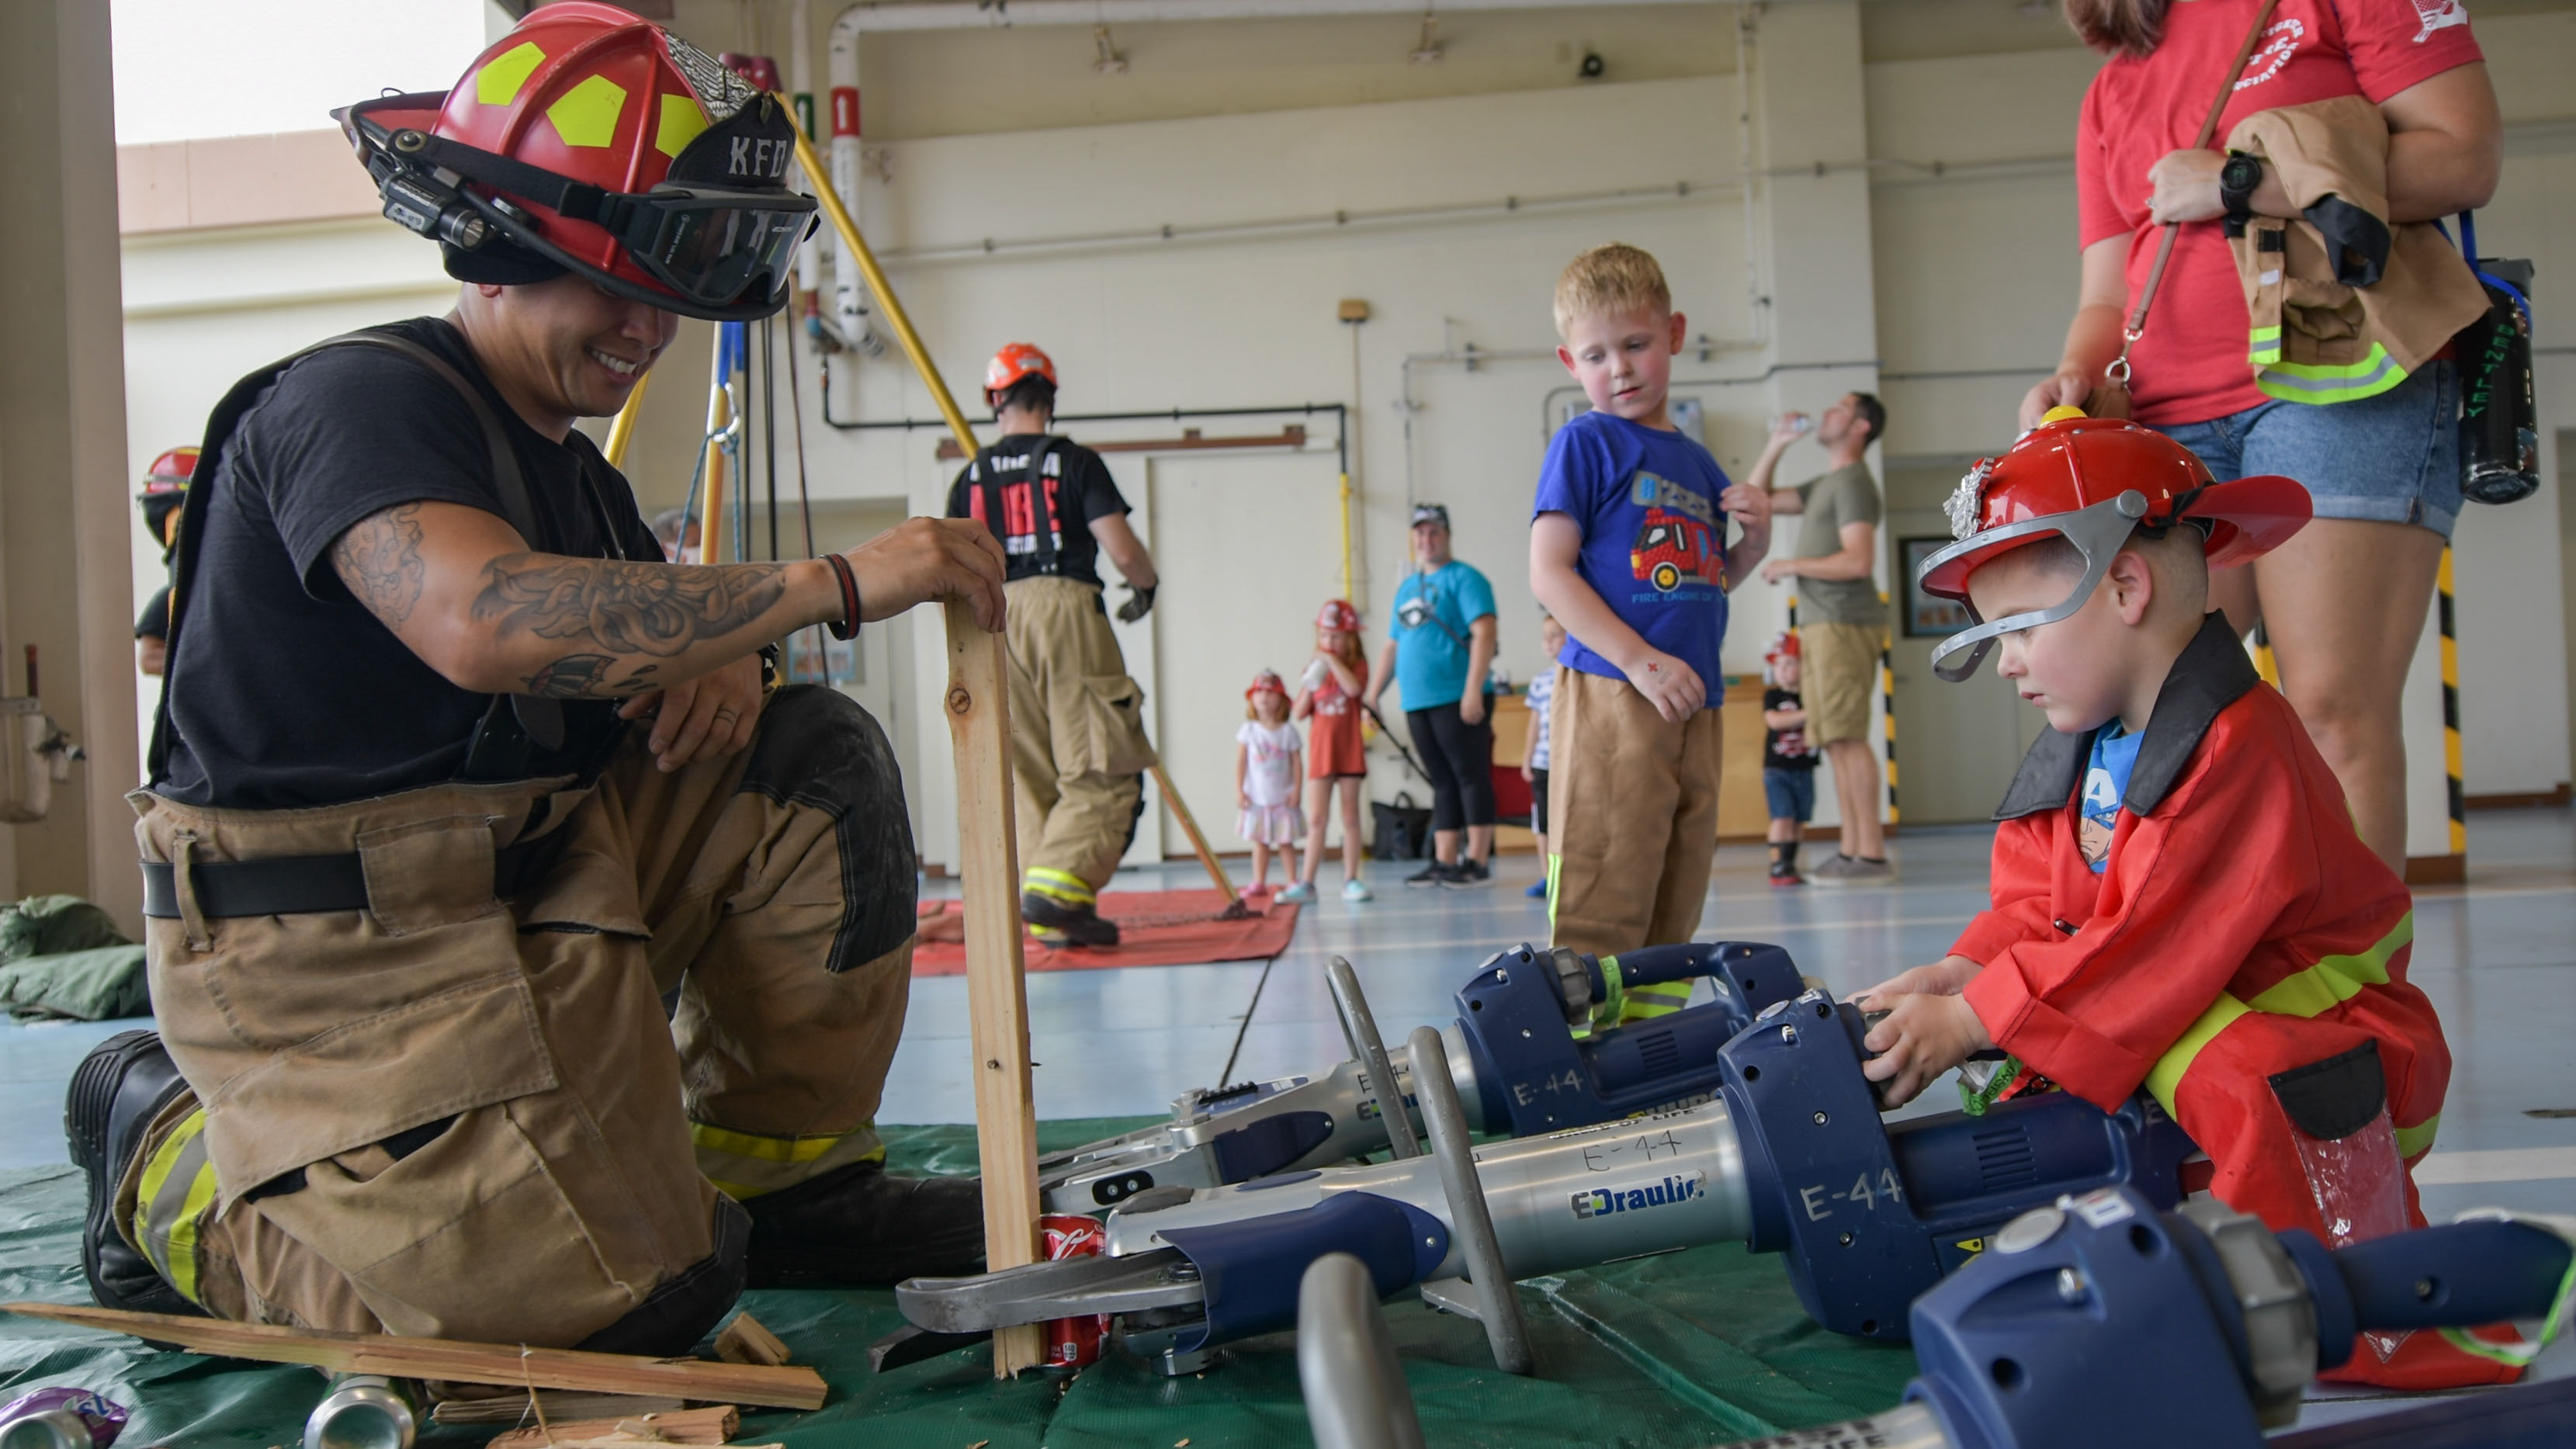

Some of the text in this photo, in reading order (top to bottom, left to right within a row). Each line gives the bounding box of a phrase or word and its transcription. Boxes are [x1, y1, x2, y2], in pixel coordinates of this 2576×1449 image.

[728, 136, 788, 178] KFD
[2467, 323, 2516, 419] BENTLEY
[1631, 592, 1659, 604] FIRE
[1800, 1167, 1902, 1222] E-44
